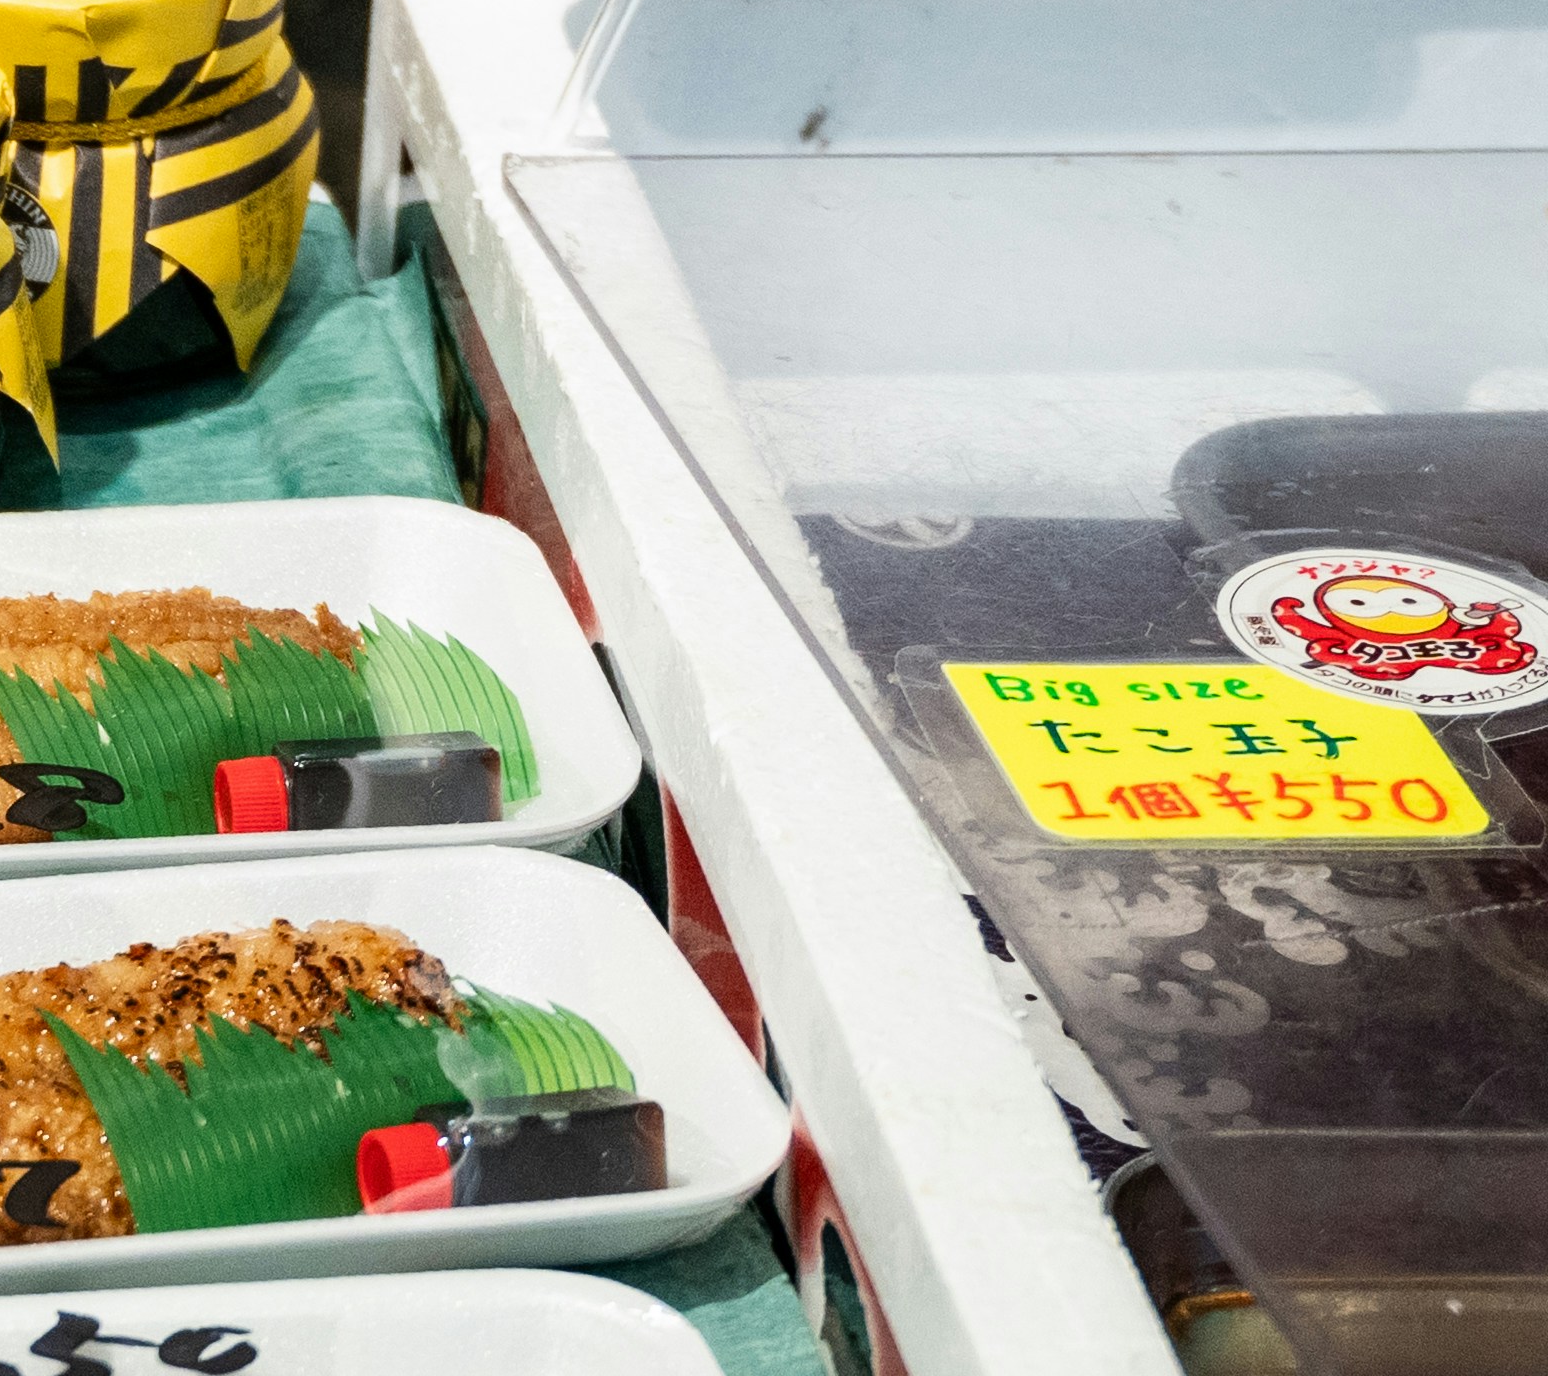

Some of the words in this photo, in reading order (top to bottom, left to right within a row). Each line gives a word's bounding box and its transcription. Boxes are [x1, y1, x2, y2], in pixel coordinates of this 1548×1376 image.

[1349, 640, 1482, 665] タコ玉子
[984, 673, 1099, 707] Big
[1314, 664, 1548, 703] タコの頭にタマゴが入ってる
[1030, 719, 1358, 760] たこ玉子
